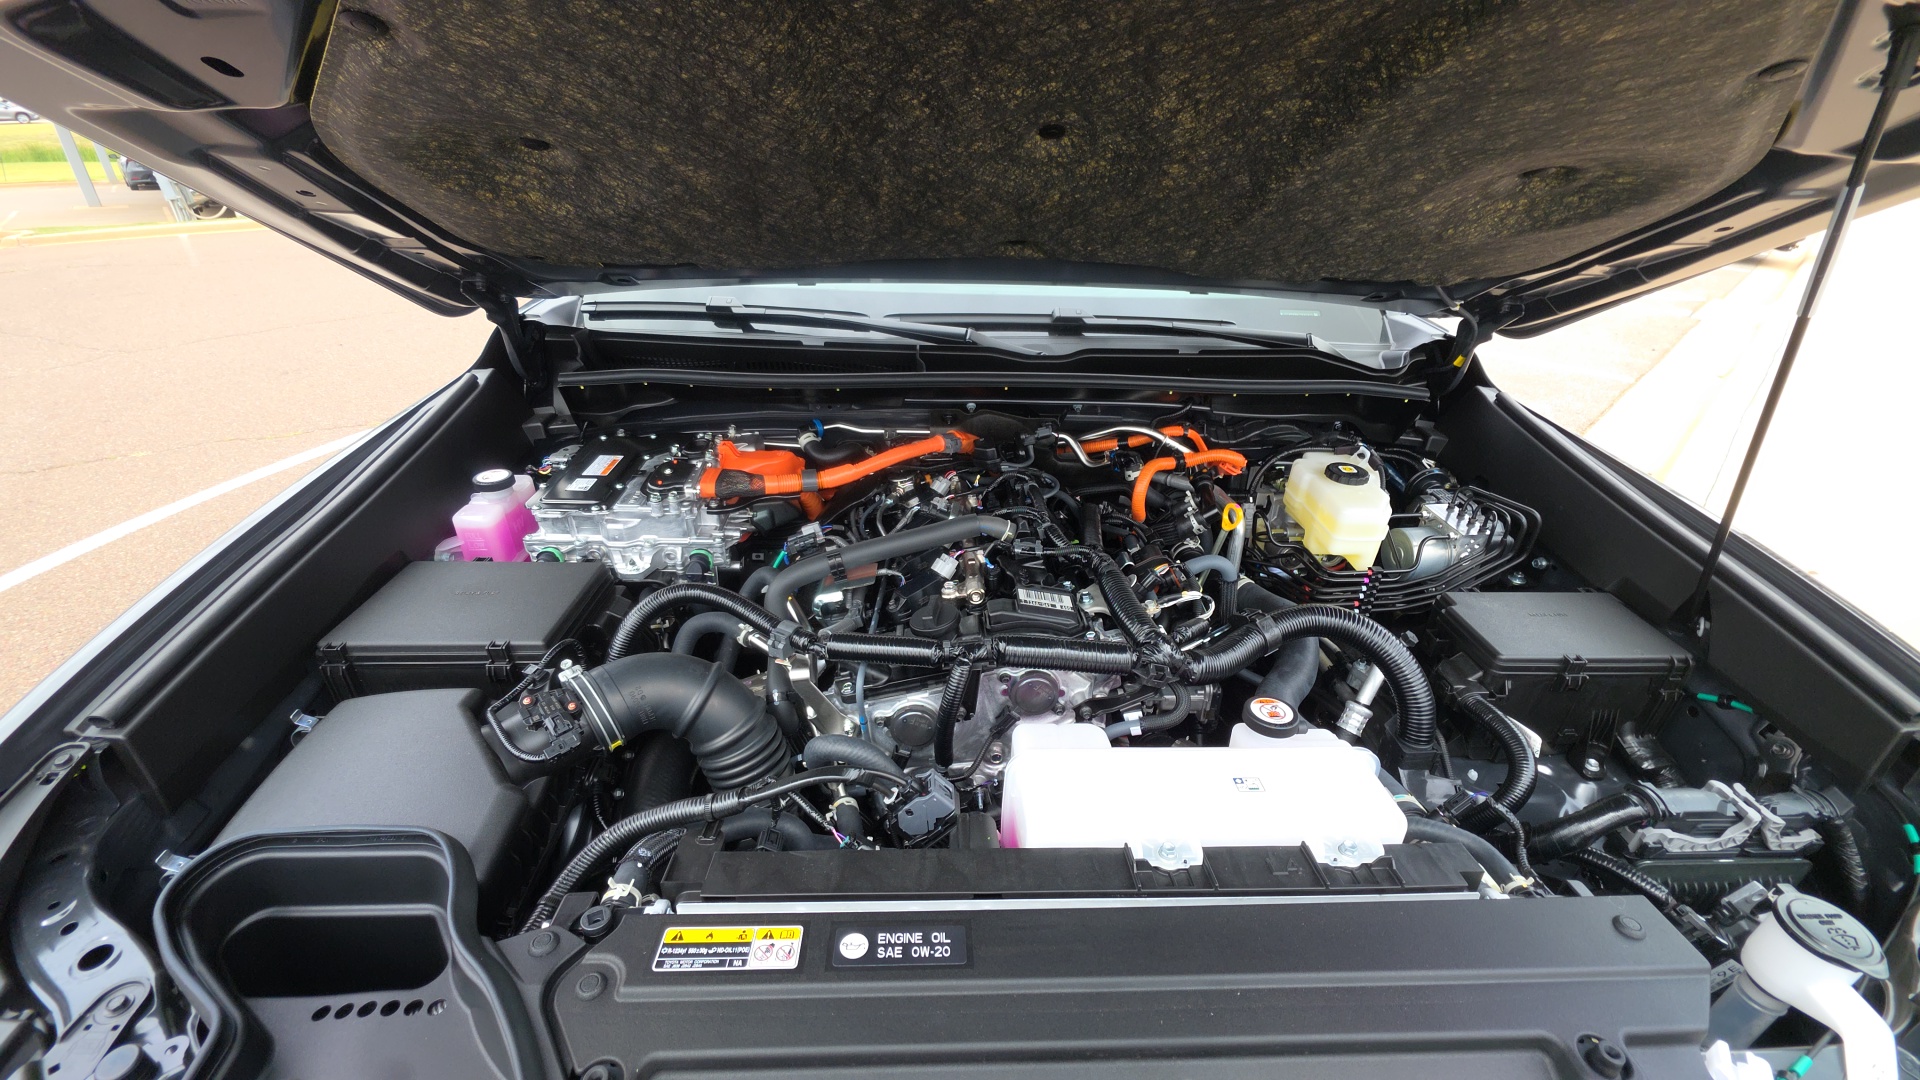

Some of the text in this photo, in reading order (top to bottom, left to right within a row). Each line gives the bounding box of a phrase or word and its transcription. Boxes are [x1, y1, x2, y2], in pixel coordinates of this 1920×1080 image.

[877, 932, 951, 944] ENGINE OIL
[877, 946, 951, 958] SAE 0W-20
